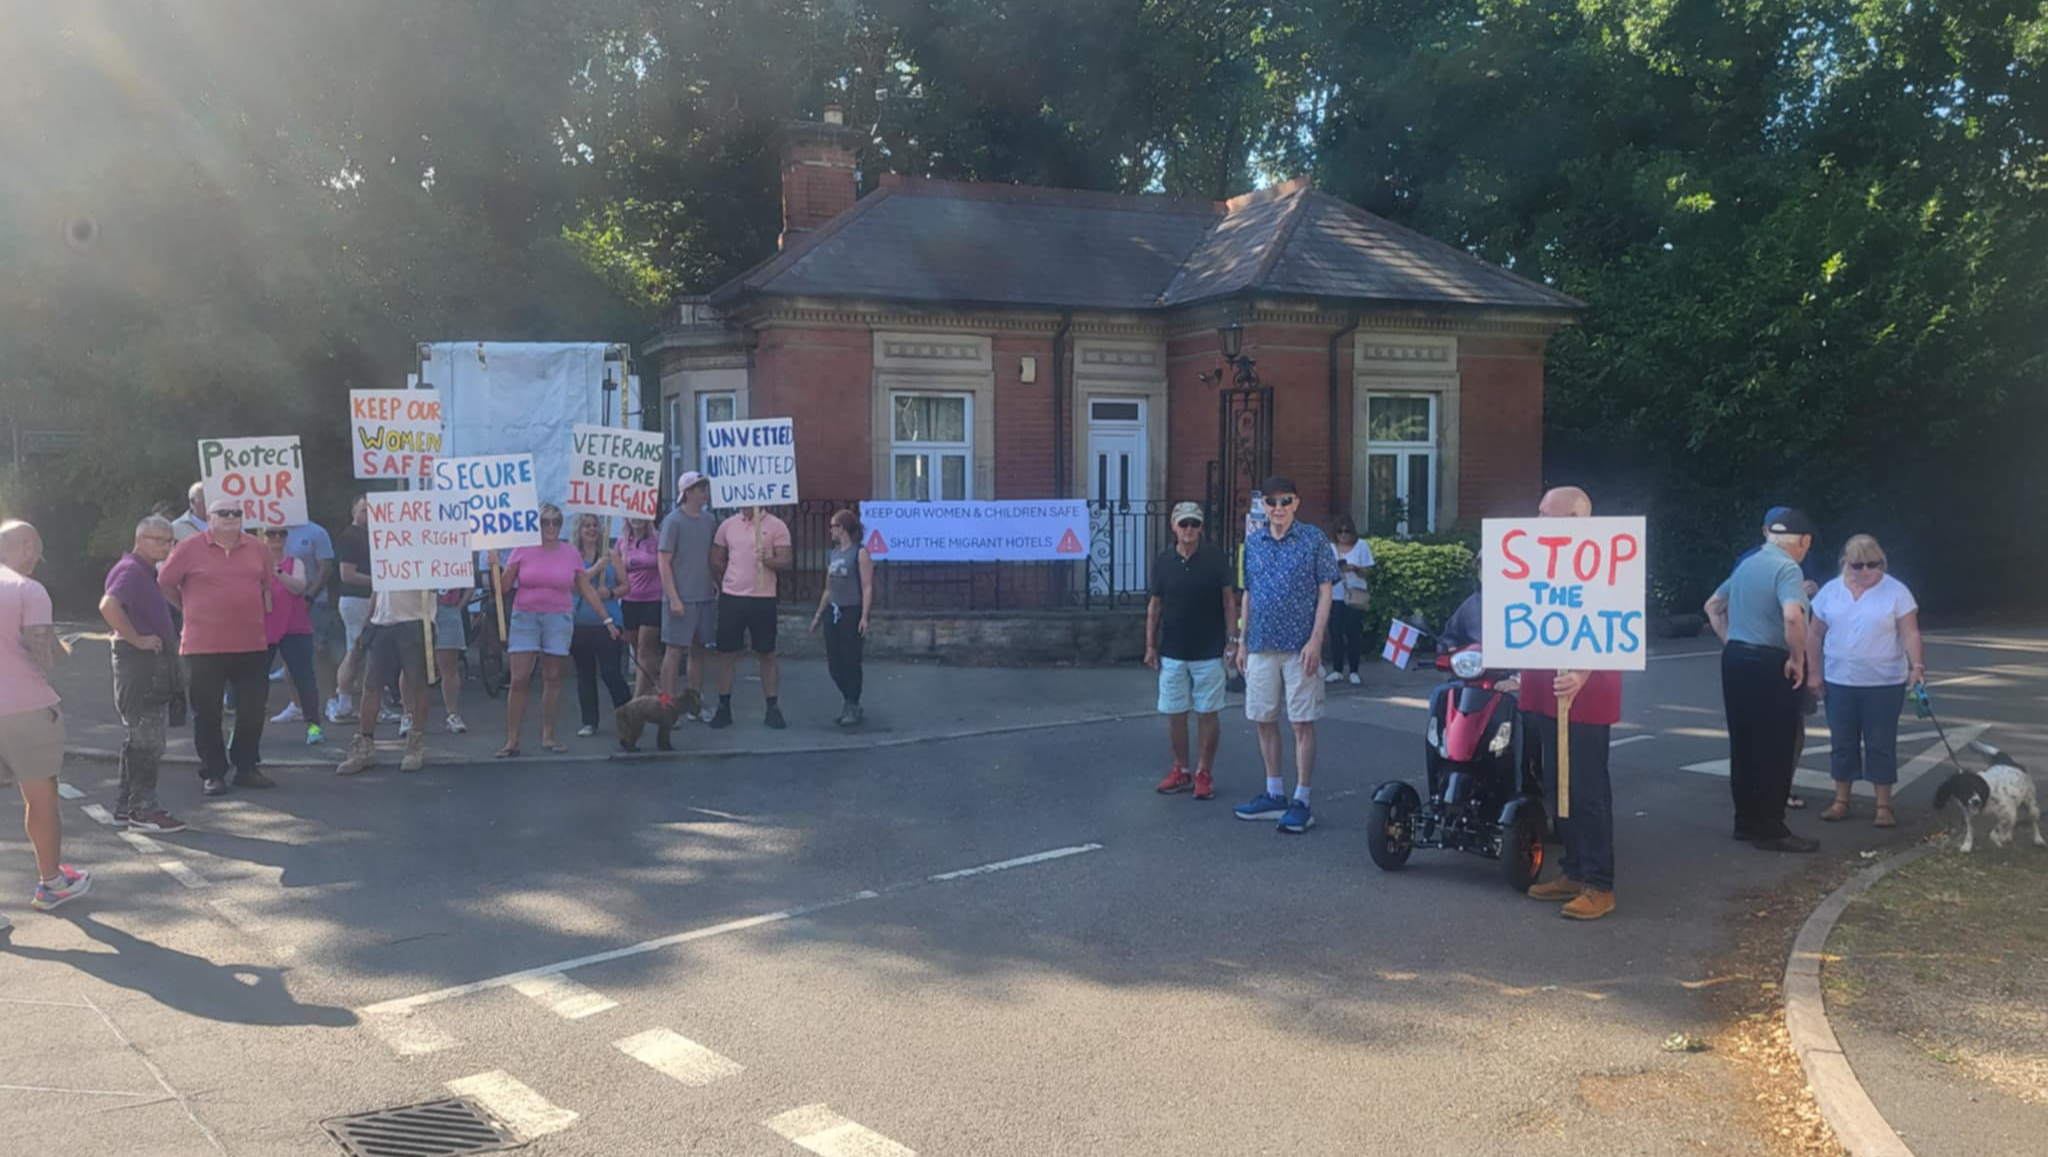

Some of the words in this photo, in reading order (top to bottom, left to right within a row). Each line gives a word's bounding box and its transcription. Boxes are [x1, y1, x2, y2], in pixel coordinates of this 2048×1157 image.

[354, 397, 401, 420] KEEP
[407, 400, 442, 420] OUR
[358, 425, 443, 451] WOMEN
[573, 432, 663, 463] VETERANS
[708, 424, 793, 449] UNVETTED
[363, 451, 434, 477] SAFE
[436, 460, 532, 490] SECURE
[582, 460, 656, 487] BEFORE
[707, 454, 794, 478] UNINVITED
[222, 471, 294, 499] OUR
[567, 480, 657, 515] ILLEGALS
[721, 484, 791, 503] UNSAFE
[367, 502, 395, 523] WE
[400, 501, 432, 522] ARE
[439, 500, 470, 522] NOT
[469, 492, 511, 511] OUR
[865, 508, 892, 518] KEEP
[895, 508, 921, 518] OUR
[924, 507, 971, 518] WOMEN
[974, 507, 982, 518] &
[984, 507, 1048, 518] CHILDREN
[1050, 506, 1079, 517] SAFE
[372, 530, 412, 549] FAR
[422, 529, 470, 547] RIGHT
[890, 537, 922, 548] SHUT
[924, 537, 945, 548] THE
[949, 537, 1003, 548] MIGRANT
[1006, 537, 1053, 548] HOTELS
[376, 559, 423, 580] JUST
[431, 560, 474, 578] RIGHT
[1502, 529, 1637, 586] STOP
[1529, 581, 1583, 608] THE
[1504, 603, 1642, 653] BOATS
